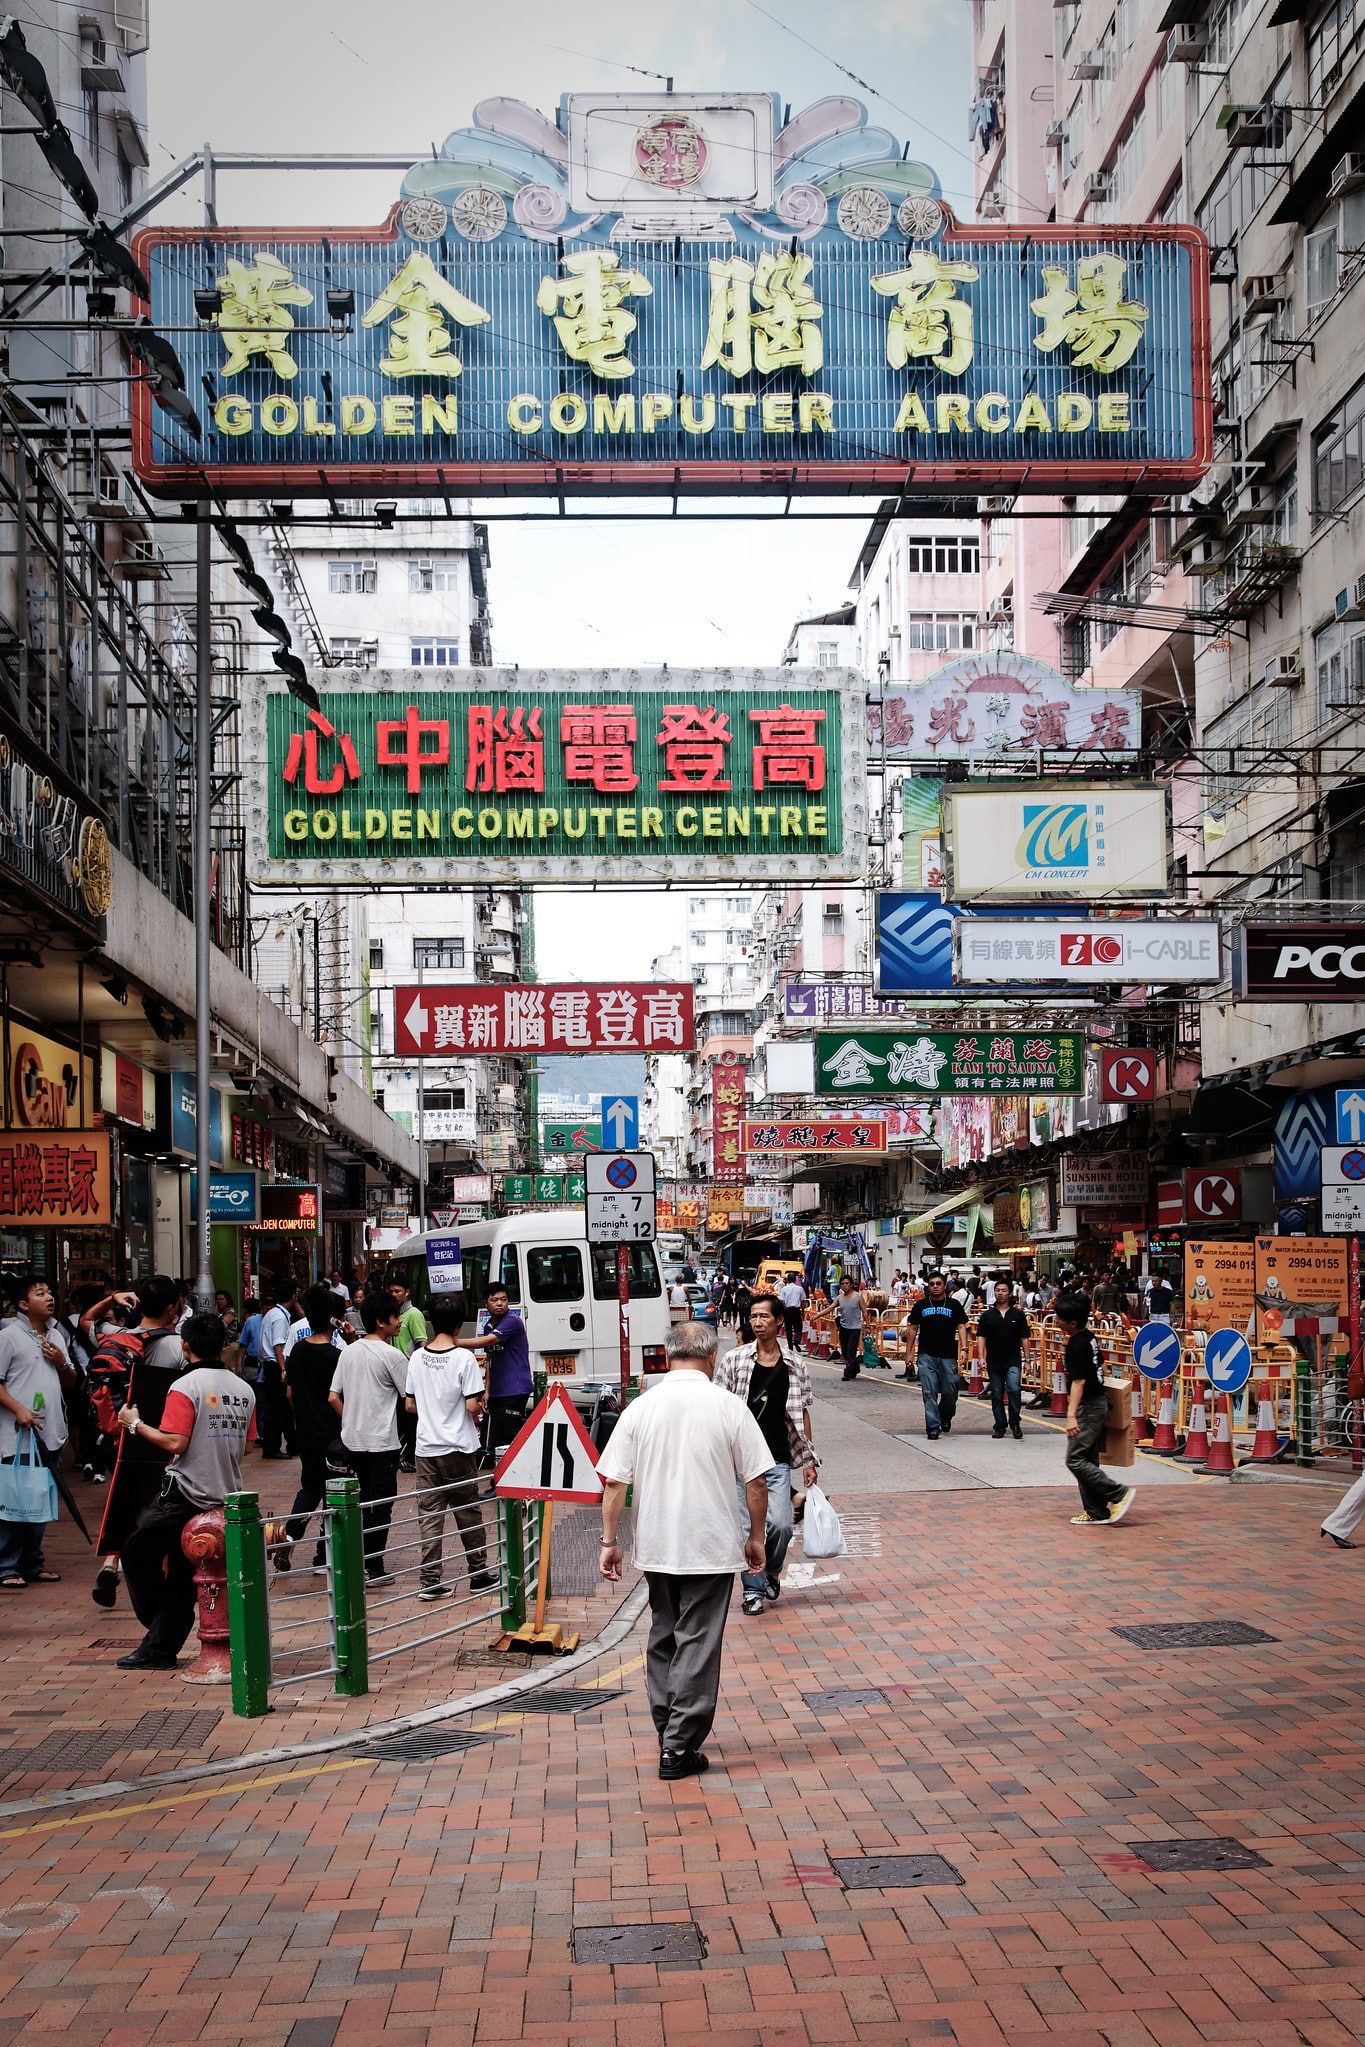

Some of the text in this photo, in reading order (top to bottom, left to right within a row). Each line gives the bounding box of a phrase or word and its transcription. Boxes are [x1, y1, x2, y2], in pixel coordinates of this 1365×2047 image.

[215, 249, 1149, 379] 黃金電腦商場
[214, 391, 1131, 436] GOLDEN COMPUTER ARCADE
[283, 804, 828, 841] GOLDEN COMPUTER CENTRE
[1025, 869, 1089, 878] CM CONCEPT
[968, 939, 1055, 961] 有線寬頻
[953, 1037, 1057, 1062] 芬蘭浴
[823, 1038, 947, 1089] 金濤
[951, 1062, 1057, 1074] KAM TO SAUNA
[954, 1077, 1055, 1088] 領有合法牌照
[1066, 1172, 1146, 1182] SUNSHINE HOTEL
[299, 1193, 316, 1217] 高
[600, 1204, 619, 1212] 上午
[631, 1197, 642, 1212] 7
[1325, 1212, 1361, 1222] midnight
[278, 1218, 315, 1230] COMPUTER
[591, 1220, 629, 1229] midnight
[633, 1222, 651, 1238] 12
[1333, 1221, 1352, 1230] 午夜
[600, 1230, 620, 1239] 午夜
[1214, 1259, 1237, 1269] 2994
[1288, 1257, 1339, 1269] 2994 0155
[938, 1307, 953, 1317] STATE
[548, 1365, 573, 1375] 1035
